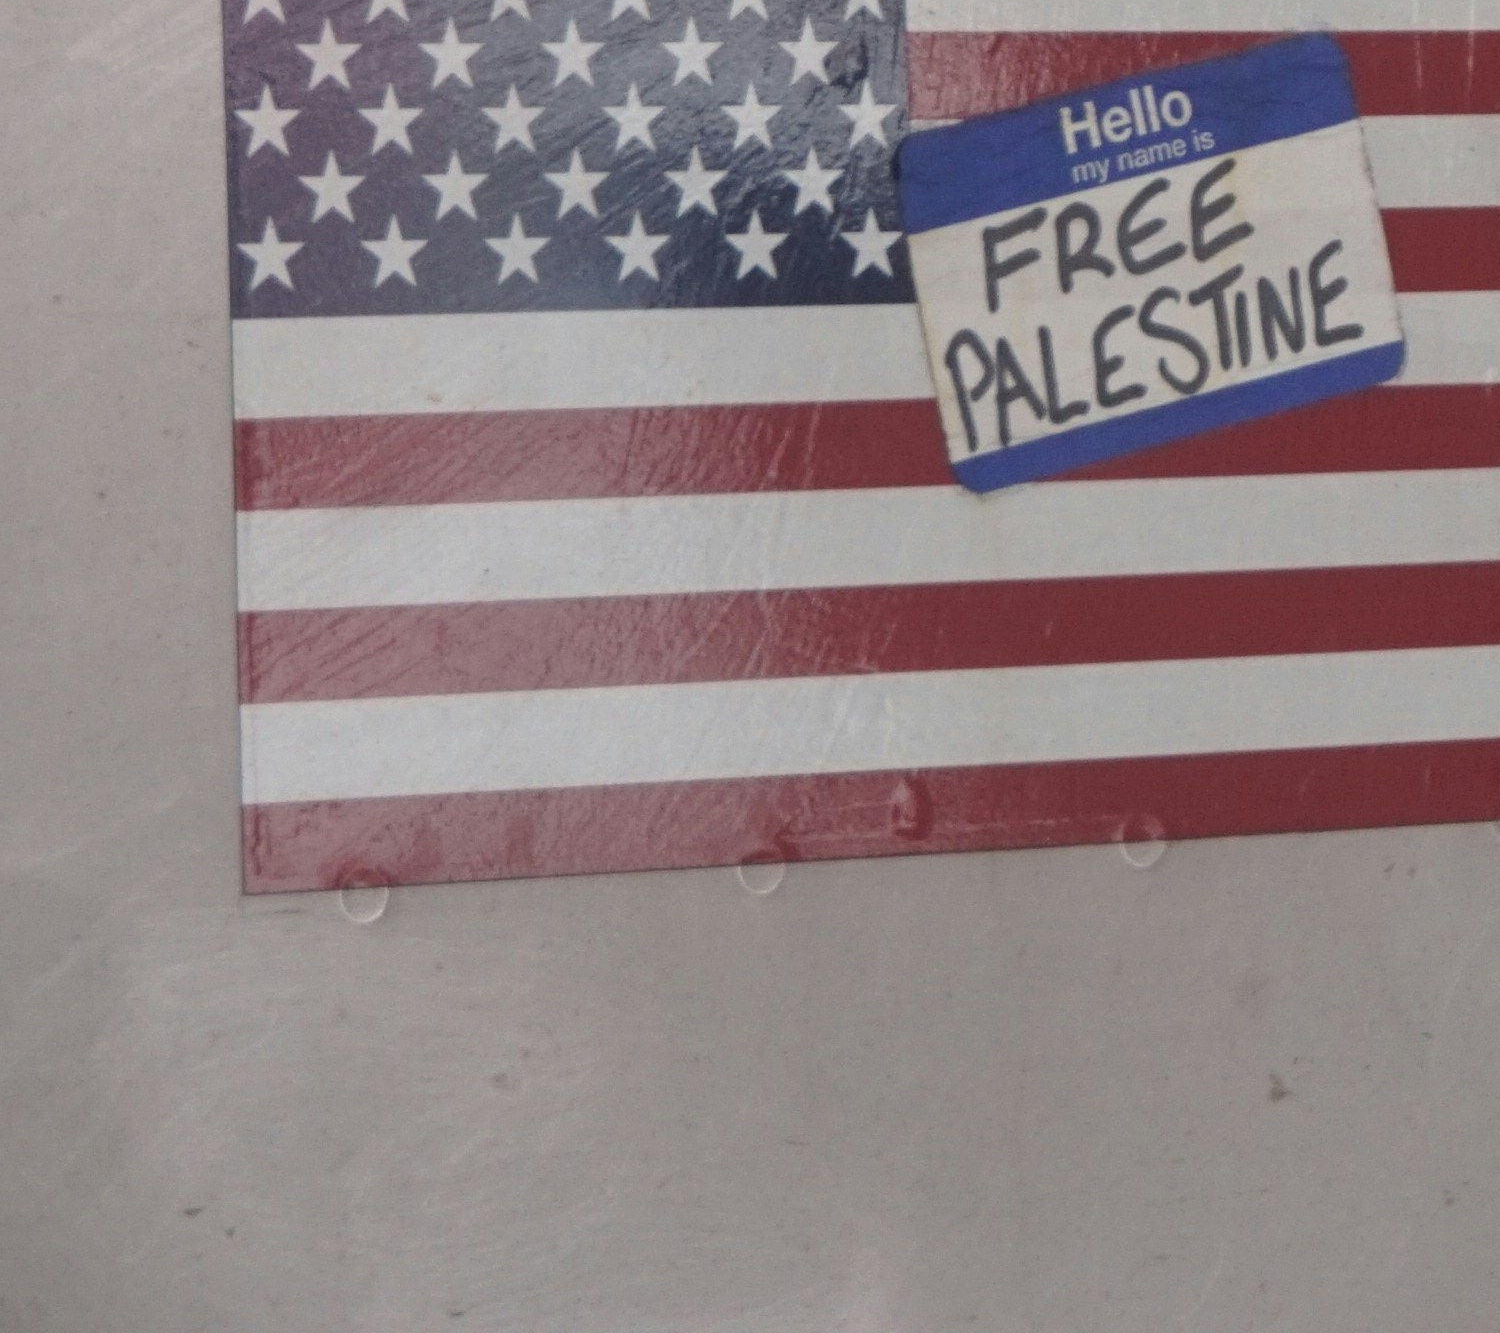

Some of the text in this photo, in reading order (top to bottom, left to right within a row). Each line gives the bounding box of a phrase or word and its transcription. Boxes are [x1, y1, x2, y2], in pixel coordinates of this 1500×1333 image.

[1058, 85, 1192, 153] Hello
[1071, 128, 1216, 184] my name is
[982, 158, 1255, 313] FREE
[945, 239, 1365, 452] PALESTINE
